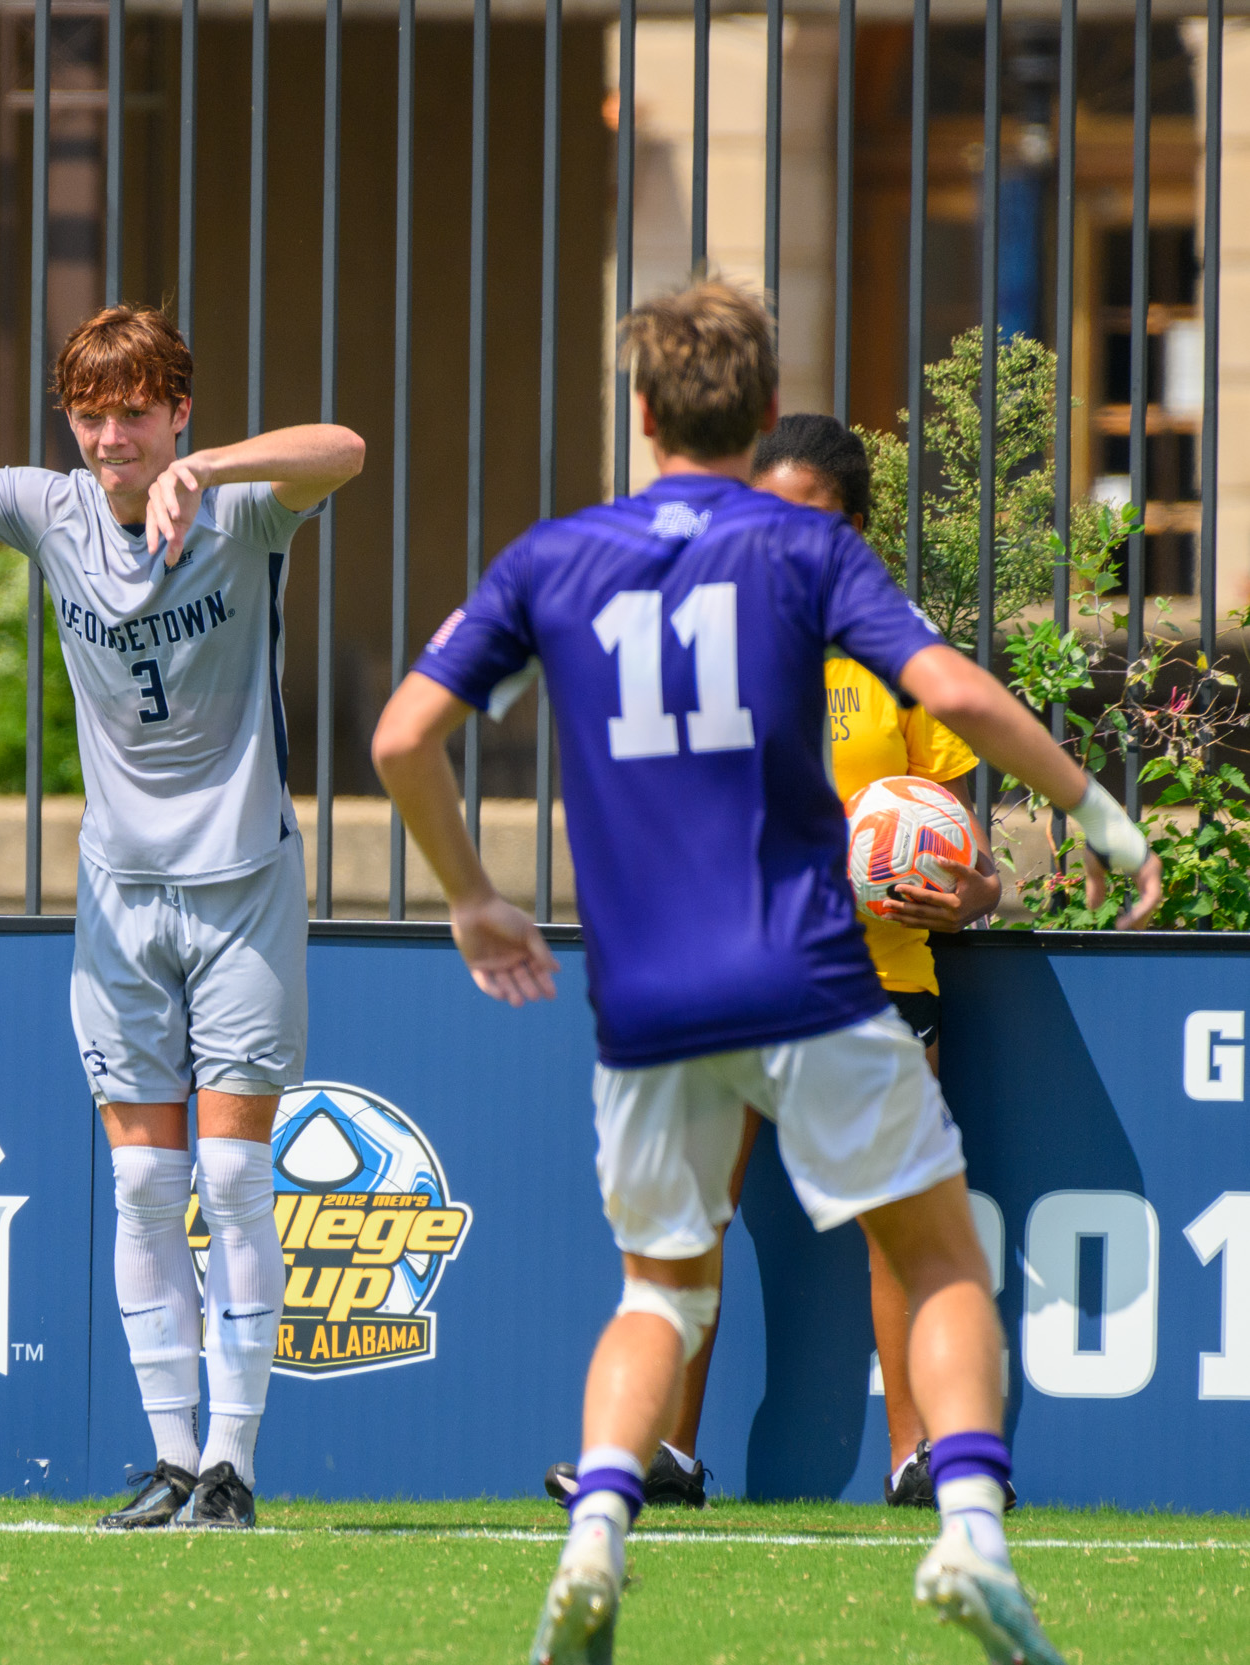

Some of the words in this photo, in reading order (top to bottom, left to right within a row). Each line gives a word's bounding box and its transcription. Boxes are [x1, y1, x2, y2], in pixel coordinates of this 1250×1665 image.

[130, 657, 170, 725] 3
[592, 581, 755, 760] 11
[323, 1194, 366, 1207] 2012
[282, 1253, 393, 1322] up
[869, 1189, 1250, 1400] 01
[11, 1343, 44, 1362] TM
[310, 1324, 421, 1360] ALABAMA
